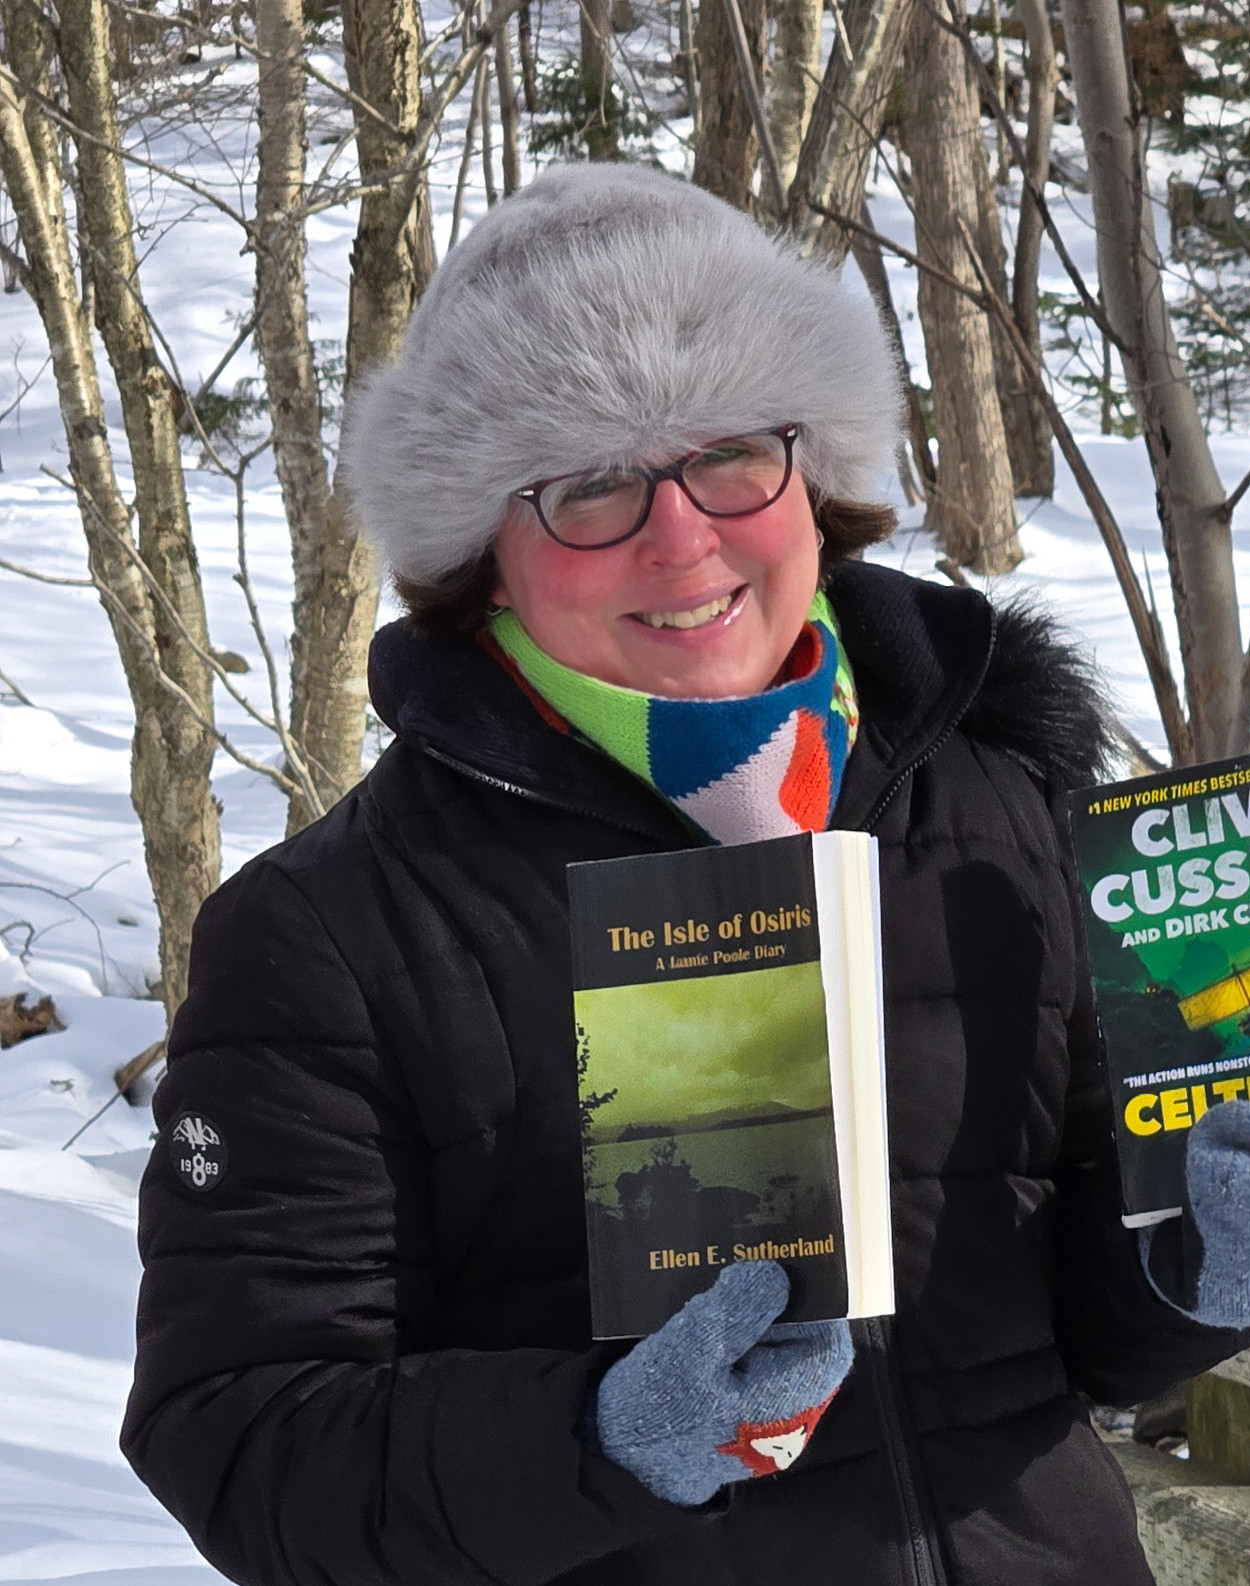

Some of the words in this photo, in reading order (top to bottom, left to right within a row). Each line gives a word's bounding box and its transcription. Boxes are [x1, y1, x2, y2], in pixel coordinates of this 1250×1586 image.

[1103, 794, 1132, 813] NEW
[1134, 787, 1168, 806] YORK
[1171, 778, 1207, 800] TIMES
[607, 926, 655, 952] The
[663, 919, 710, 946] Isle
[718, 913, 744, 940] of
[750, 904, 811, 934] Osiris
[1121, 927, 1162, 949] AND
[1165, 907, 1230, 940] DIRK
[656, 957, 665, 971] A
[713, 948, 751, 964] Poole
[754, 944, 787, 959] Diary
[1148, 1067, 1186, 1084] ACTION
[1187, 1062, 1214, 1078] RUNS
[650, 1249, 700, 1270] Ellen
[707, 1246, 727, 1265] E.
[733, 1234, 835, 1261] Sutherland
